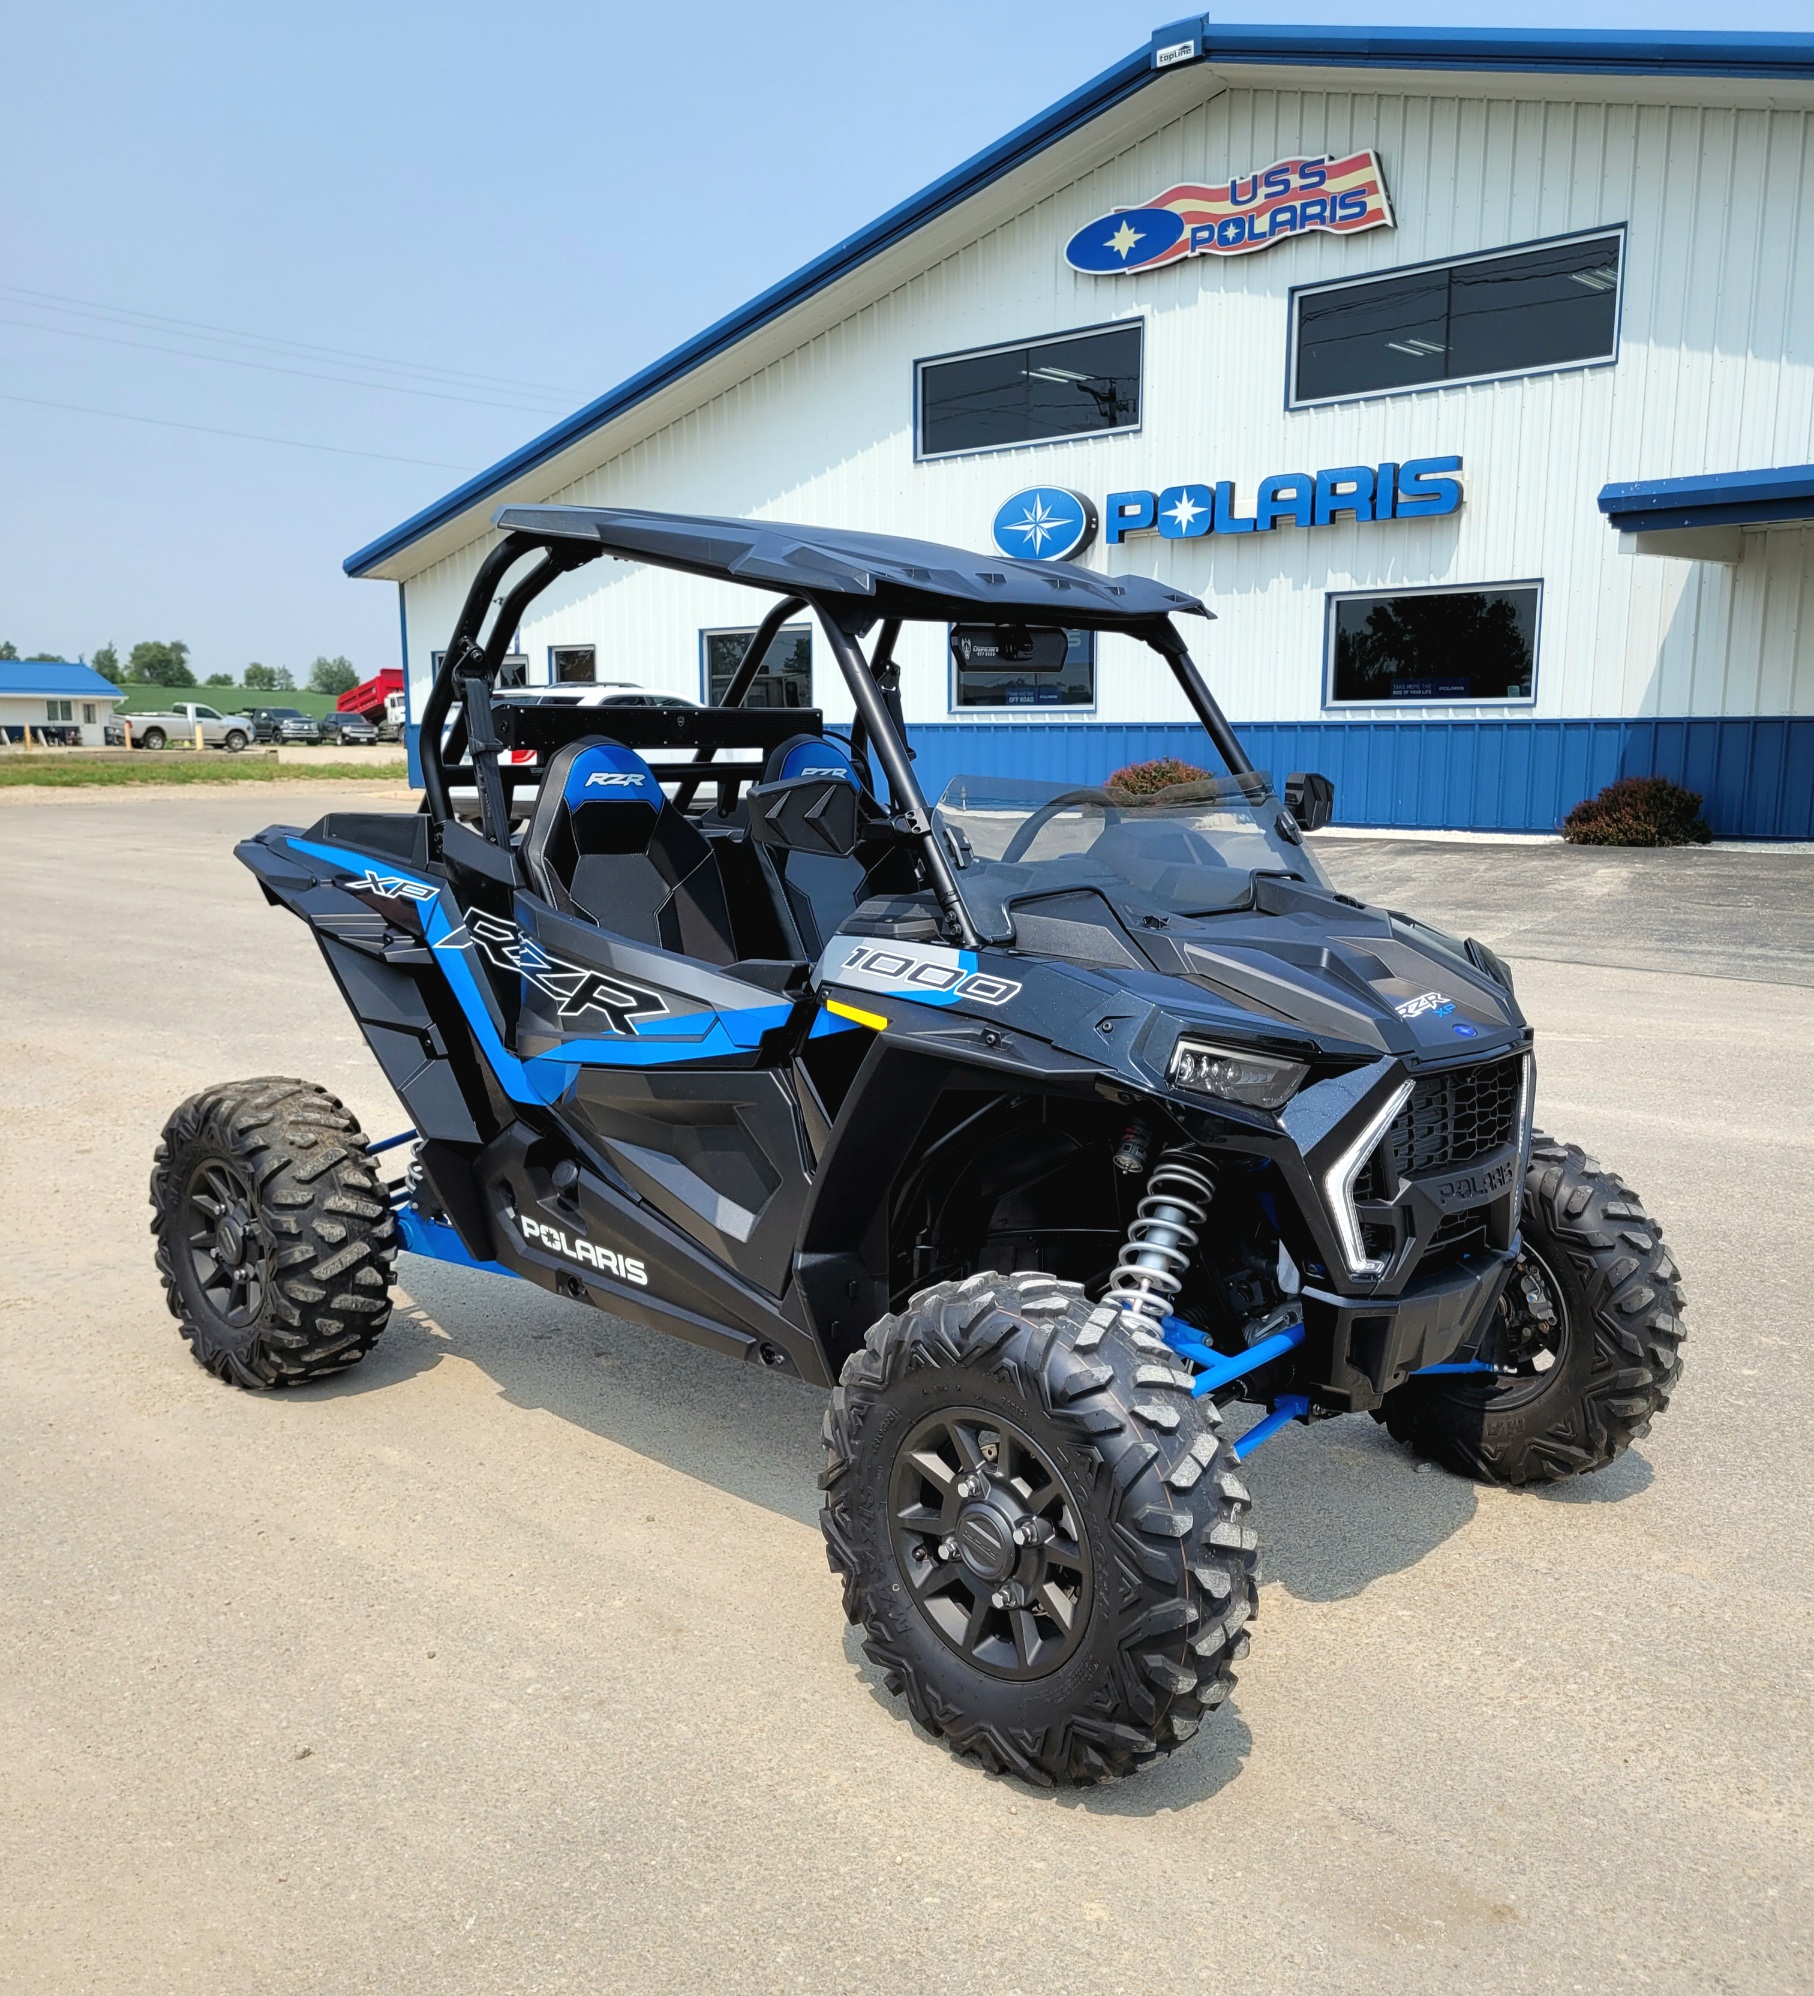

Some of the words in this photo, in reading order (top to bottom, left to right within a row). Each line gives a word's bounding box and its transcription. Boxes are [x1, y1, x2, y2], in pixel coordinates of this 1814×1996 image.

[1229, 157, 1327, 206] USS
[1190, 188, 1368, 253] POLARIS
[1106, 455, 1464, 544] POLARIS
[585, 772, 647, 788] RZR
[344, 869, 440, 901] XP
[432, 906, 670, 1035] RZR
[840, 945, 1022, 1006] 1000
[1395, 992, 1451, 1018] RZR
[1433, 1003, 1456, 1018] XP
[1438, 1161, 1512, 1205] POLARIS
[520, 1215, 648, 1286] POLARIS
